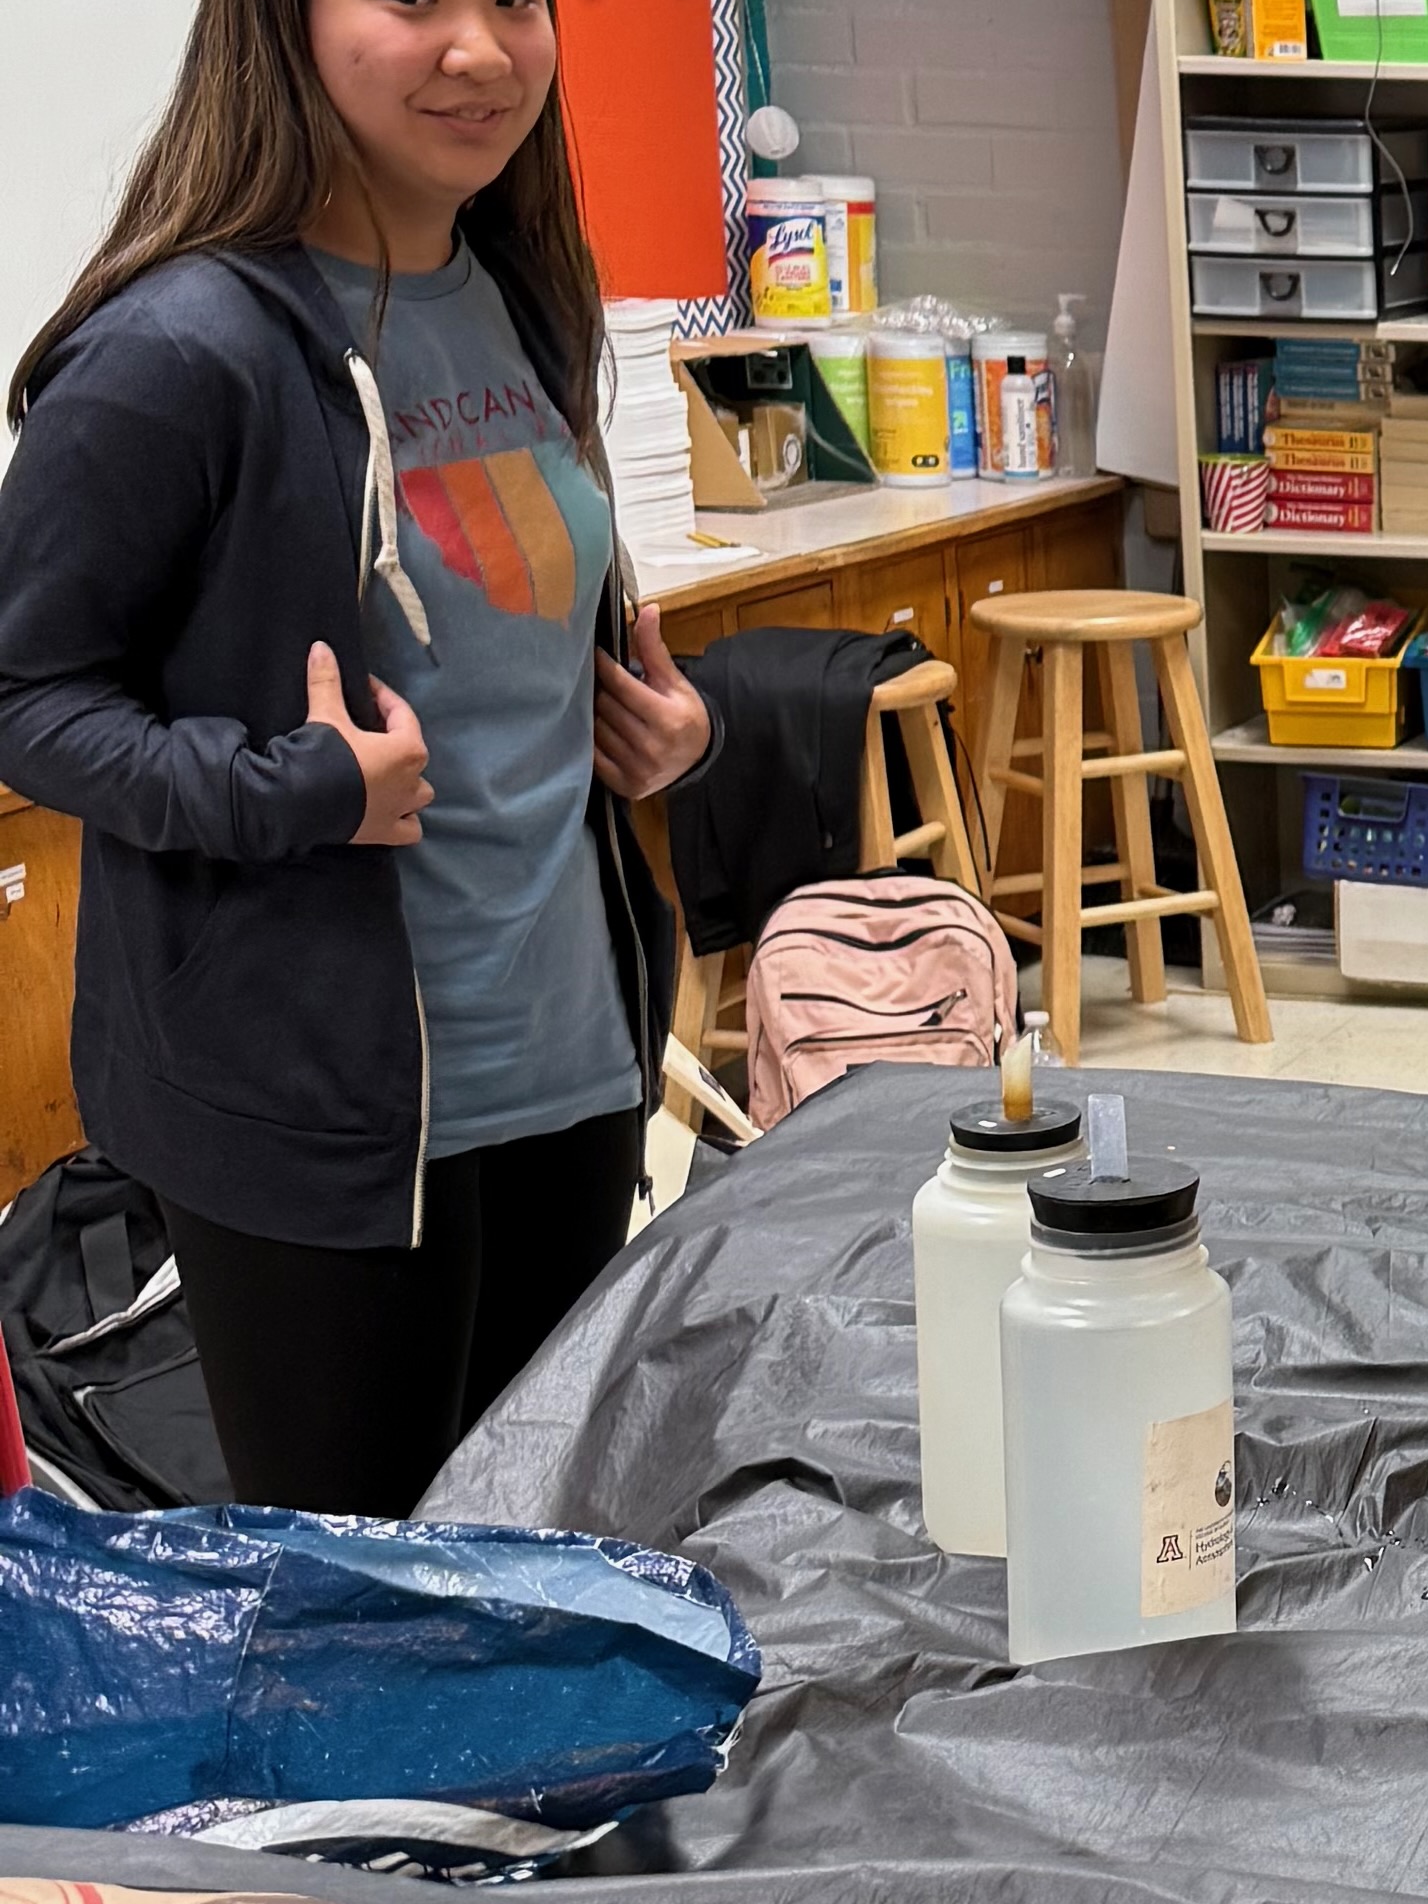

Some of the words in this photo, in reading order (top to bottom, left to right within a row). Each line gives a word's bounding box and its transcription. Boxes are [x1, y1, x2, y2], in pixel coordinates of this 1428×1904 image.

[768, 219, 814, 251] Lysol
[1278, 480, 1346, 498] Dictionary
[1279, 508, 1346, 526] Dictionary
